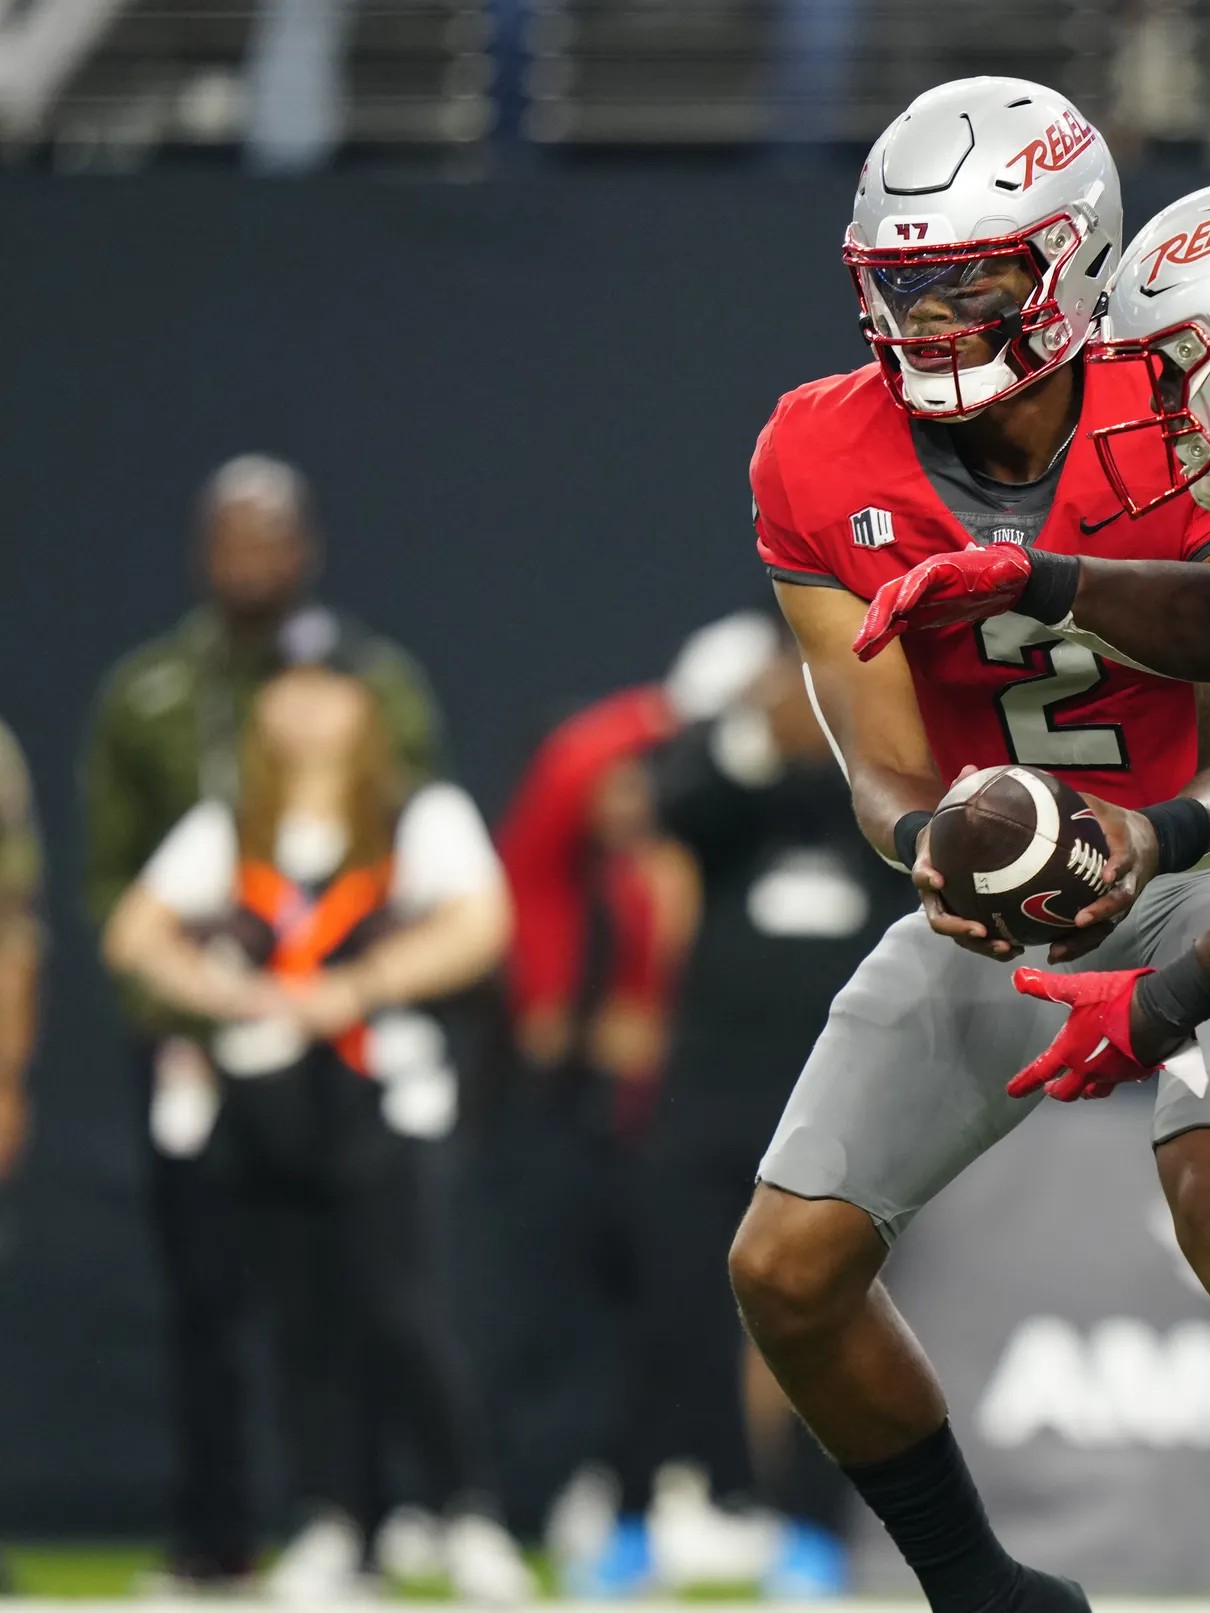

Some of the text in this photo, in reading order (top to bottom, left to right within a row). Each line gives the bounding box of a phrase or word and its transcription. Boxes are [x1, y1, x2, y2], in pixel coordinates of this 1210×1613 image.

[1005, 110, 1097, 192] REBEL
[894, 222, 929, 241] 47
[993, 528, 1025, 546] UNLV
[973, 611, 1132, 773] 2
